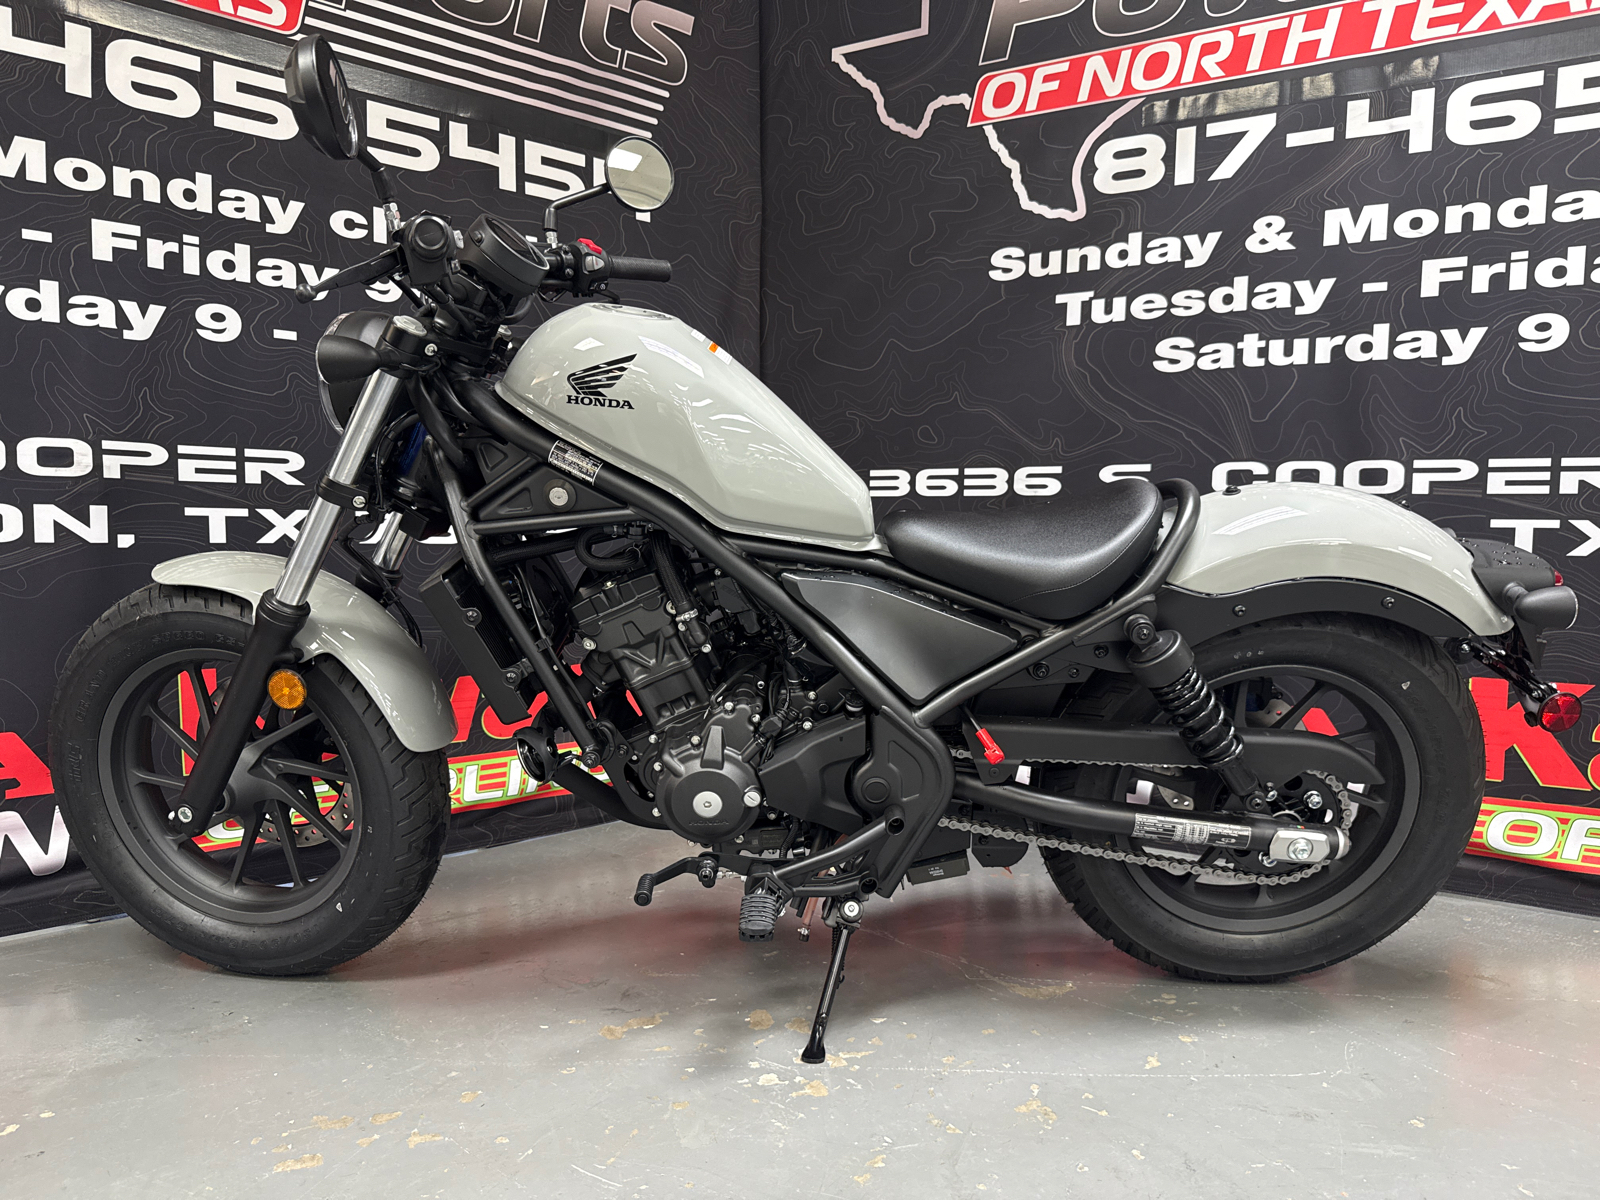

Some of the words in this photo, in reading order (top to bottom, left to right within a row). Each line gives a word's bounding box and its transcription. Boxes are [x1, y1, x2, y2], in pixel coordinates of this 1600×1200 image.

[982, 62, 1071, 119] OF
[1077, 7, 1344, 103] NORTH
[0, 135, 305, 235] Monday
[21, 228, 53, 244] -
[91, 218, 340, 301] Friday
[988, 231, 1222, 282] Sunday
[1244, 215, 1297, 254] &
[0, 278, 167, 342] day
[194, 303, 243, 343] 9
[273, 328, 298, 341] -
[1055, 276, 1337, 327] Tuesday
[1361, 281, 1389, 293] -
[1420, 245, 1600, 298] Frid
[1152, 322, 1489, 373] Saturday
[1517, 313, 1571, 353] 9
[566, 394, 635, 410] HONDA
[0, 436, 306, 486] OPER
[869, 465, 1063, 497] 3636
